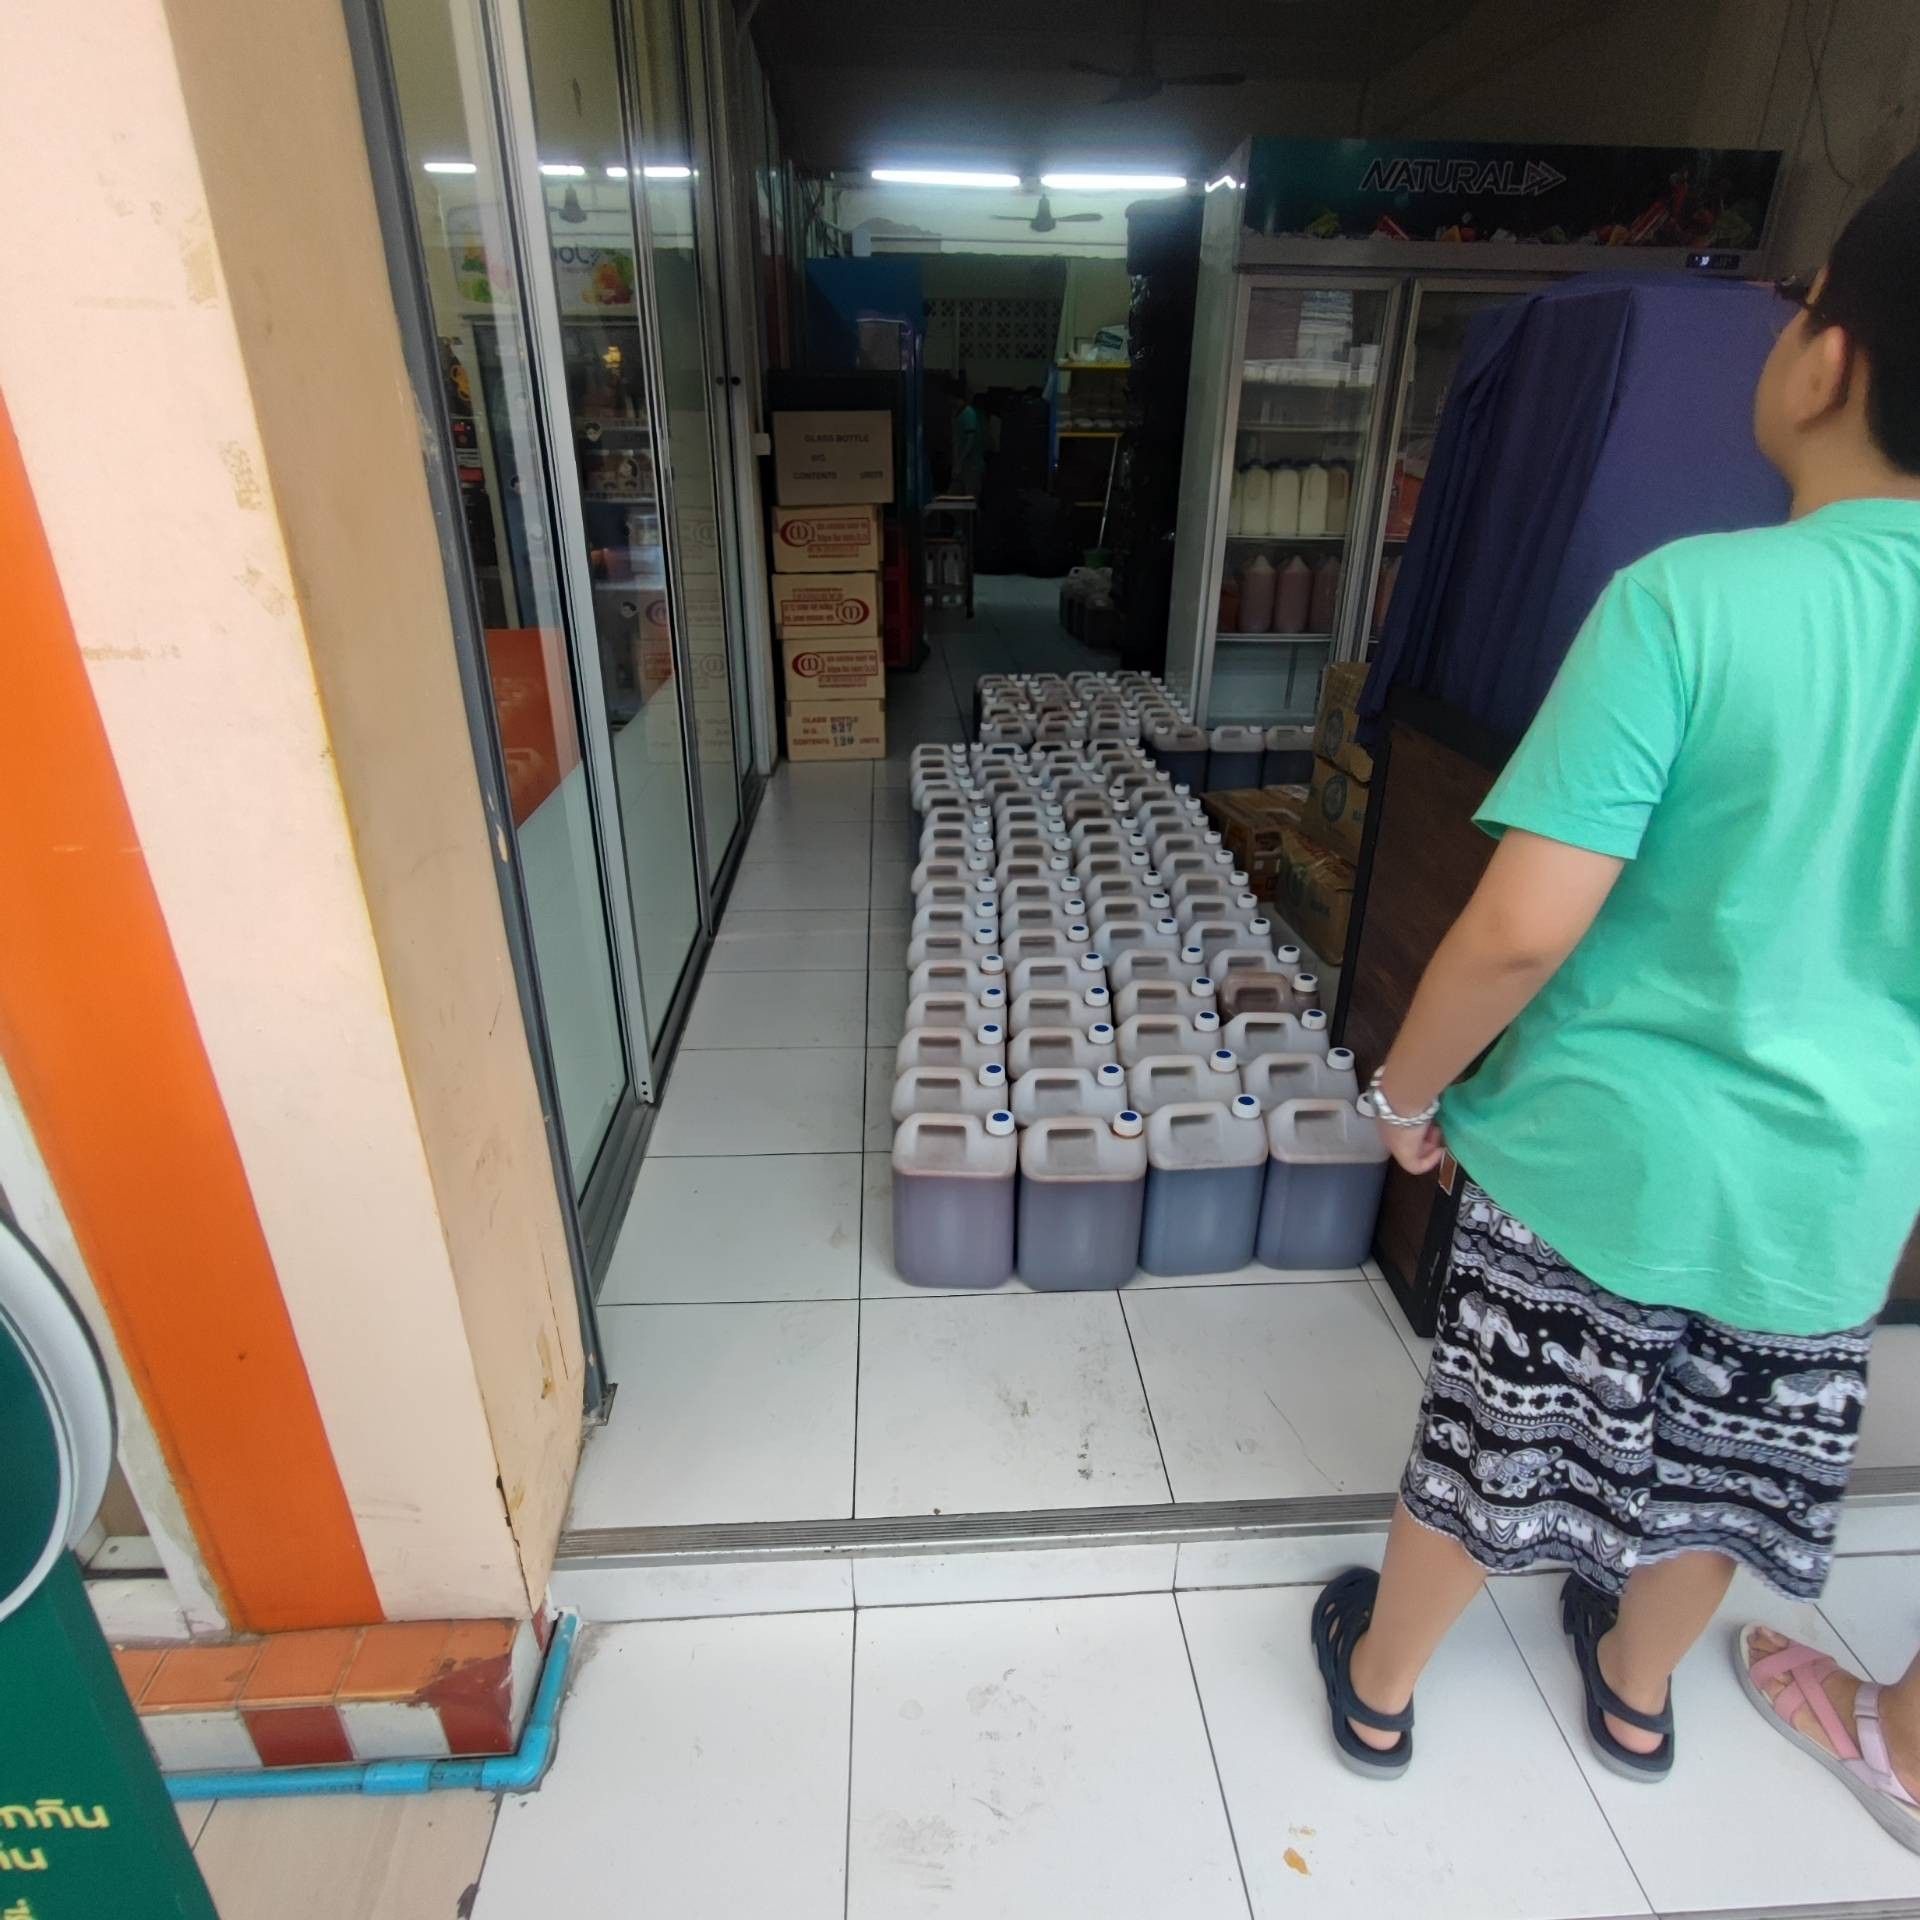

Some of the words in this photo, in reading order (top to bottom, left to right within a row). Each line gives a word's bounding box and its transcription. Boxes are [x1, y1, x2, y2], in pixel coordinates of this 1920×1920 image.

[1357, 157, 1522, 196] NATURAL
[803, 433, 834, 443] GLASS
[836, 433, 870, 443] BOTTLE
[792, 471, 838, 480] CONTENTS
